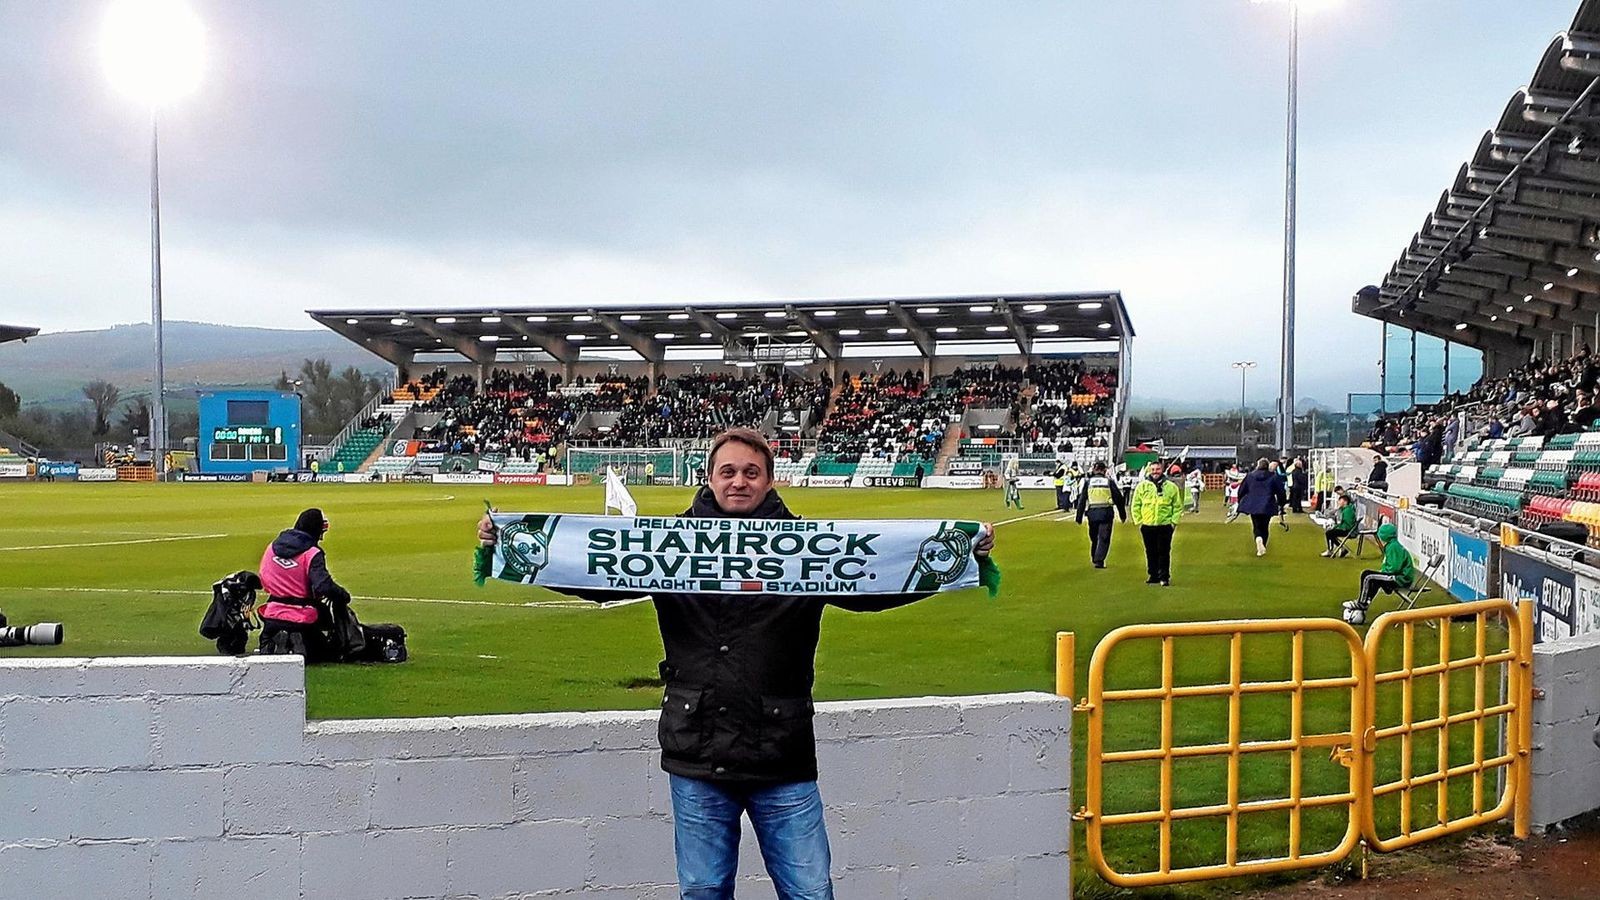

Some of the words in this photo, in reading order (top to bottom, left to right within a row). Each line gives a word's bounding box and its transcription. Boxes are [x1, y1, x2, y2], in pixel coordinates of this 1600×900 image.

[874, 477, 905, 487] ELEV8
[633, 518, 731, 530] IRELAND'S
[738, 521, 818, 532] NUMBER
[826, 522, 834, 531] 1
[588, 529, 880, 556] SHAMROCK
[587, 552, 784, 580] ROVERS
[801, 558, 877, 580] F.C.
[606, 577, 697, 590] TALLAGHT
[766, 581, 857, 592] STADIUM
